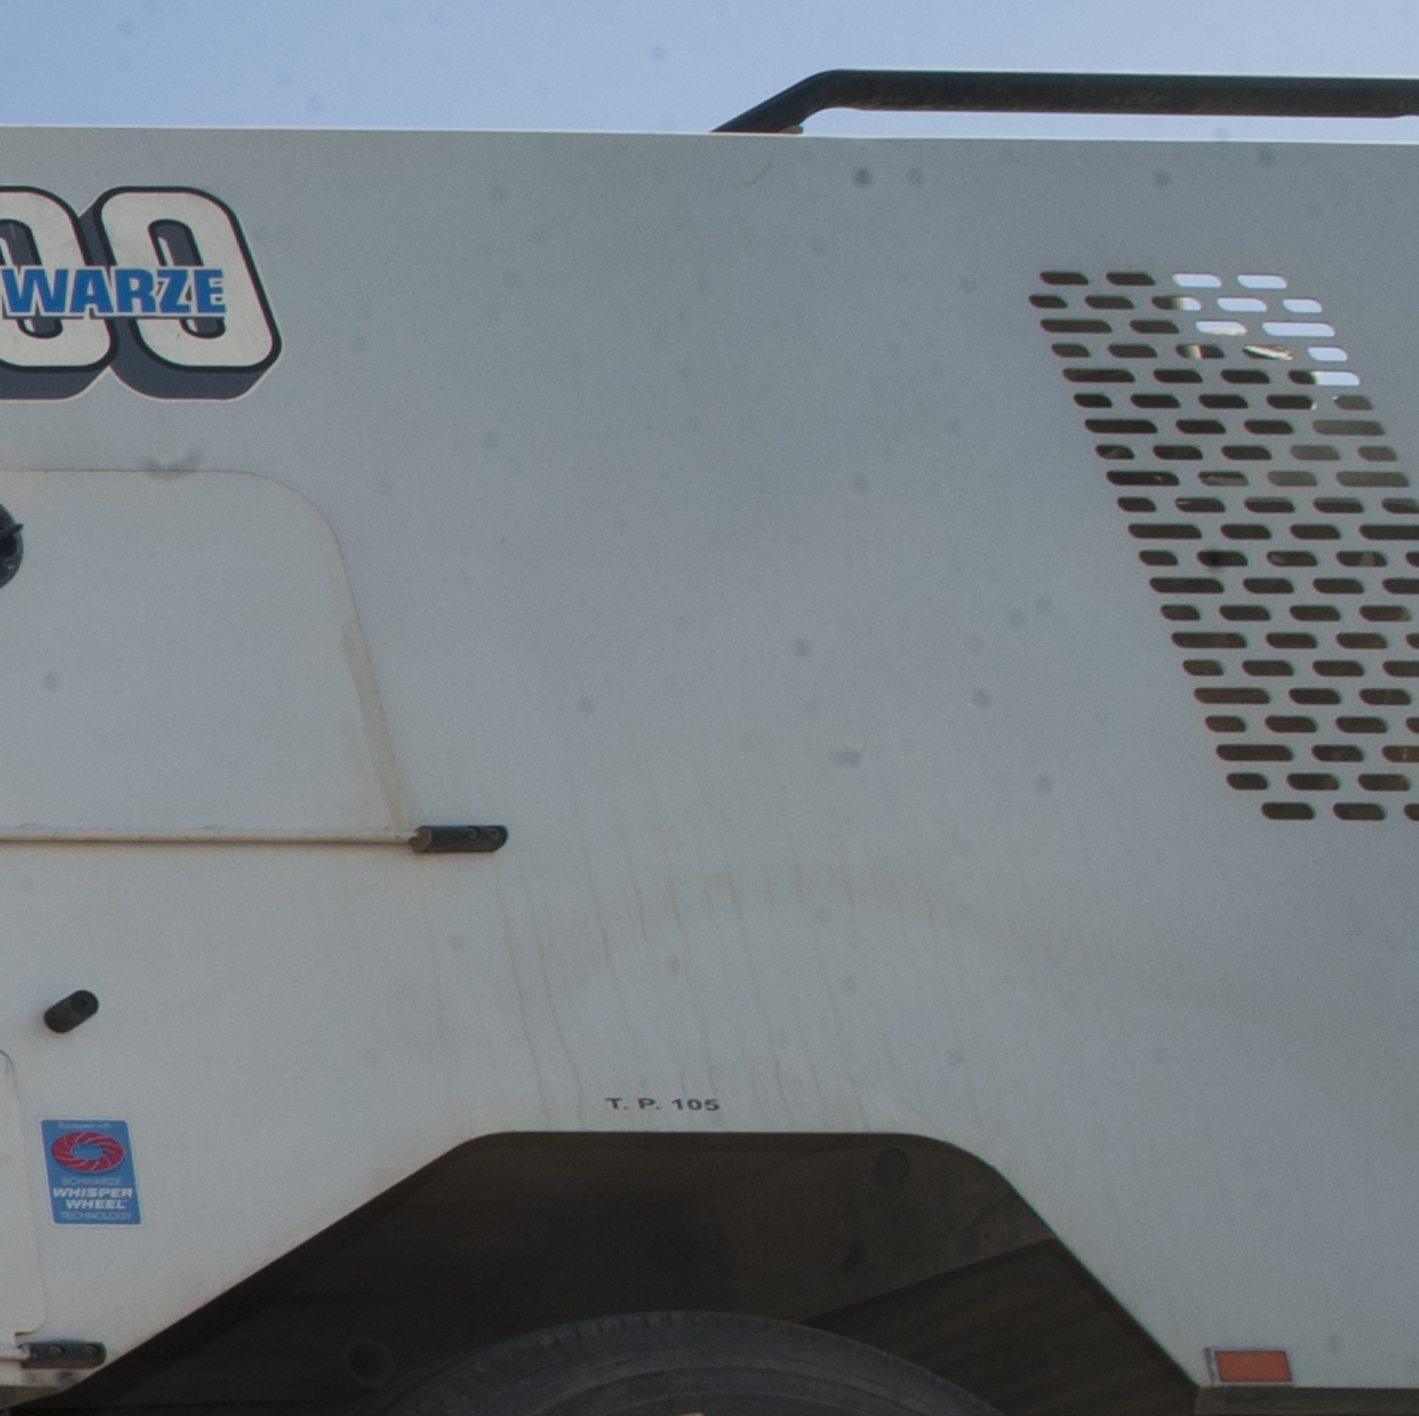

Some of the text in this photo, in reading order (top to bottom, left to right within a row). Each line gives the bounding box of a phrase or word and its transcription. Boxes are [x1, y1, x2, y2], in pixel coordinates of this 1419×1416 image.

[671, 1098, 720, 1111] 105
[52, 1187, 133, 1198] WHISPER
[65, 1199, 126, 1210] WHEEL
